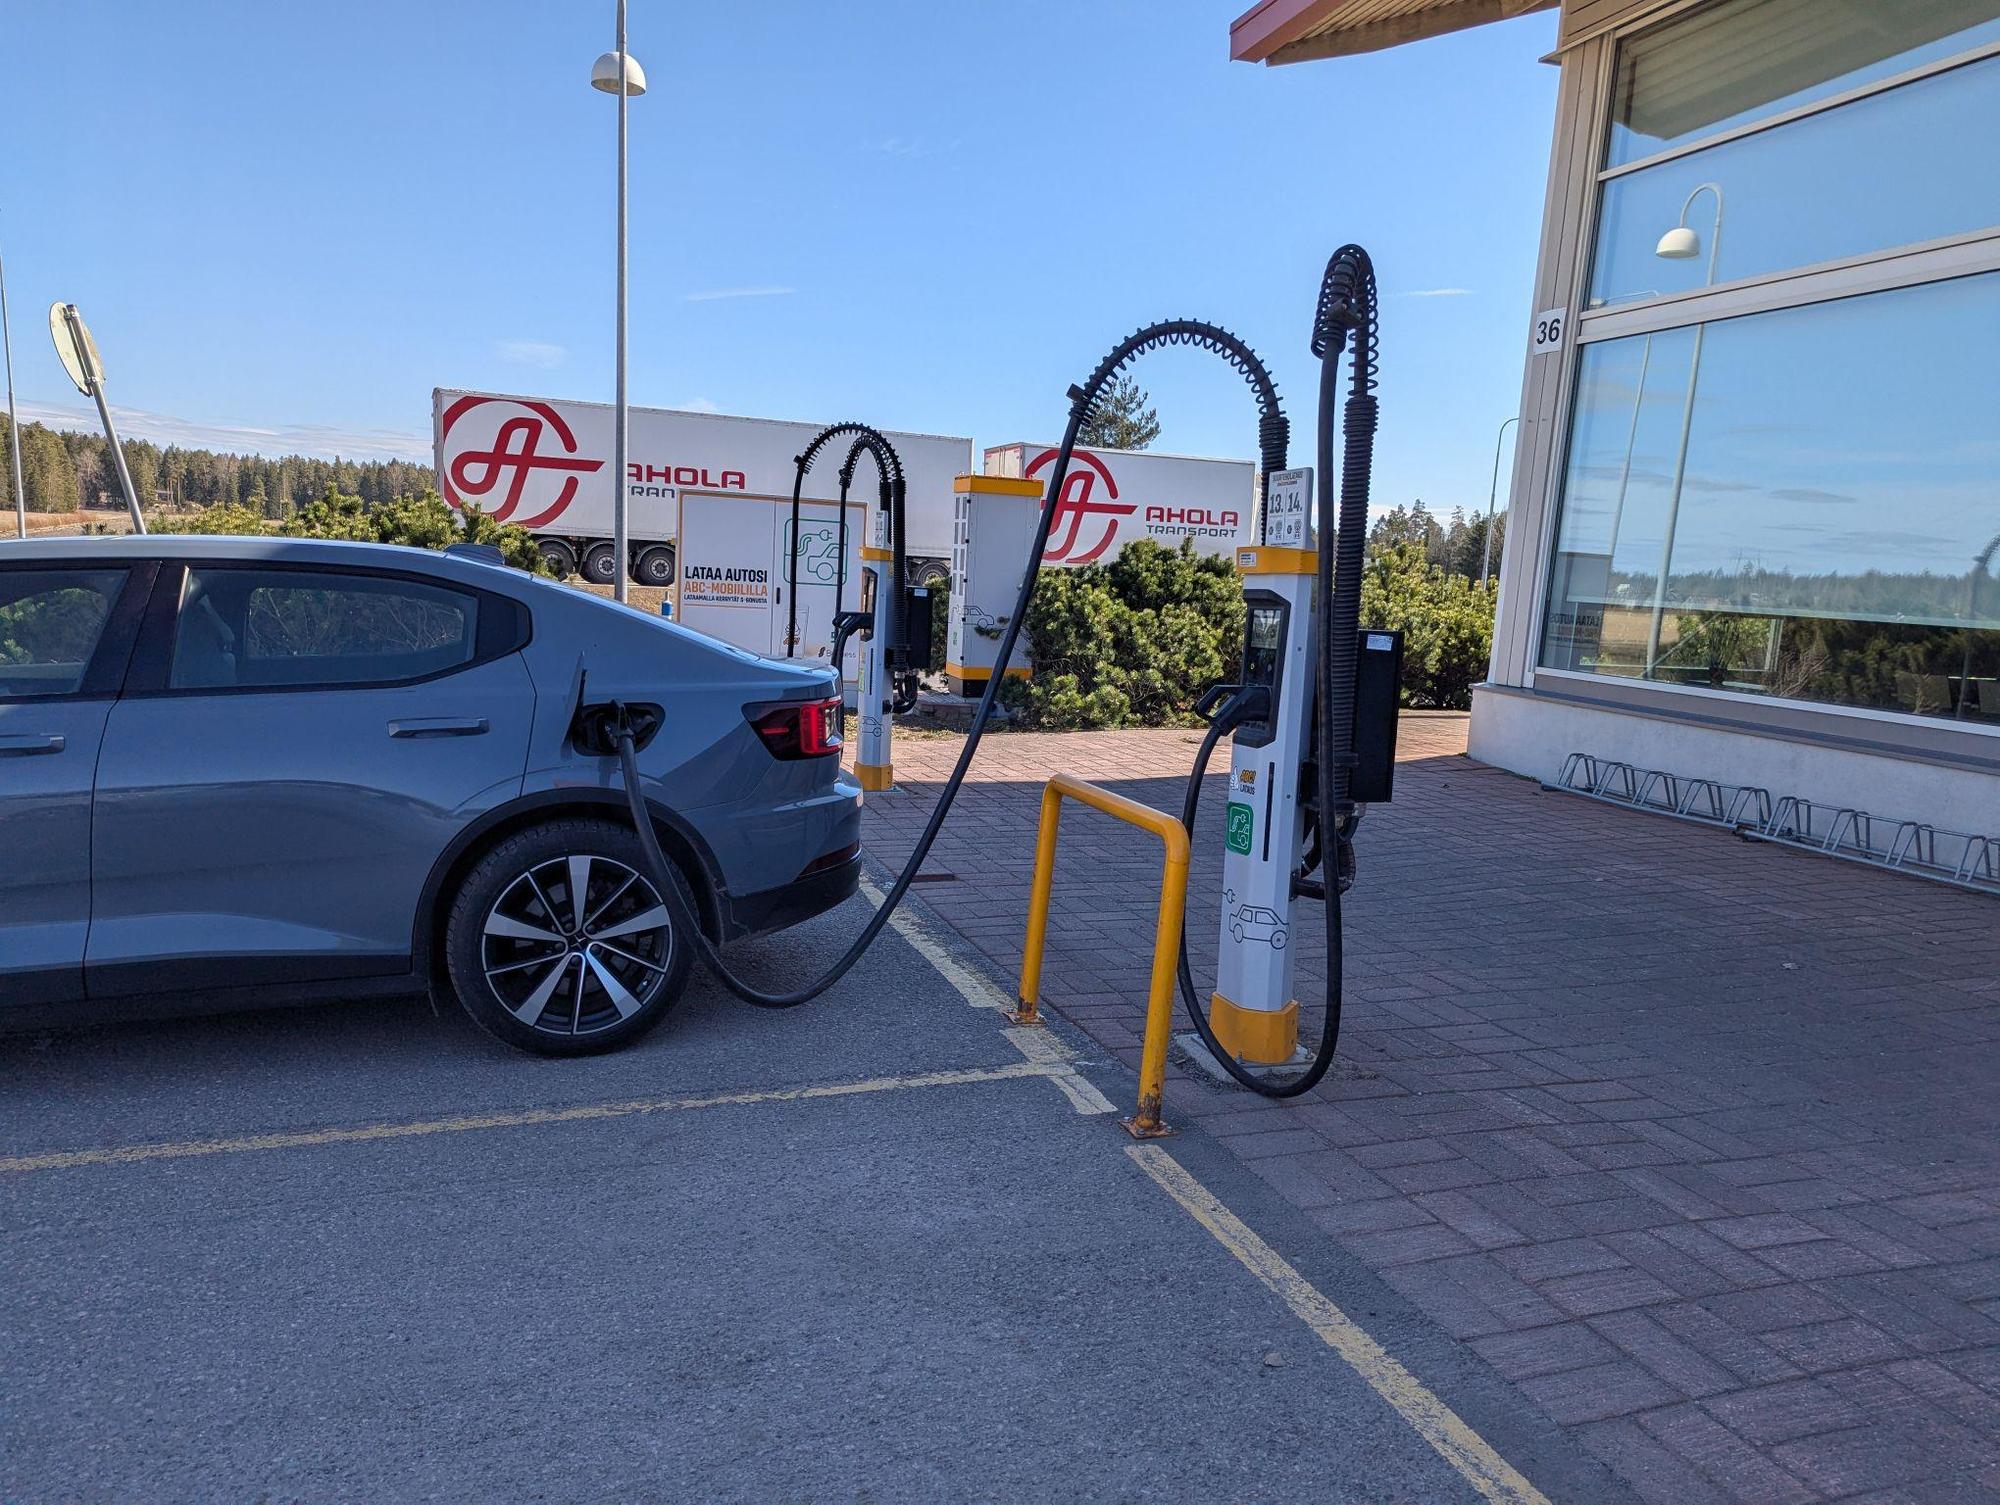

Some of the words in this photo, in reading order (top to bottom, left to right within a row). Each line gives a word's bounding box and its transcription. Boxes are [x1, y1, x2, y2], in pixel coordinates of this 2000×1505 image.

[1536, 317, 1561, 345] 36
[627, 463, 746, 490] AHOLA
[1145, 506, 1239, 527] AHOLA
[1145, 524, 1238, 538] TRANSPORT
[684, 566, 723, 581] LATAA
[725, 568, 768, 583] AUTOSI
[684, 581, 768, 597] ABC-MOBIILILLA
